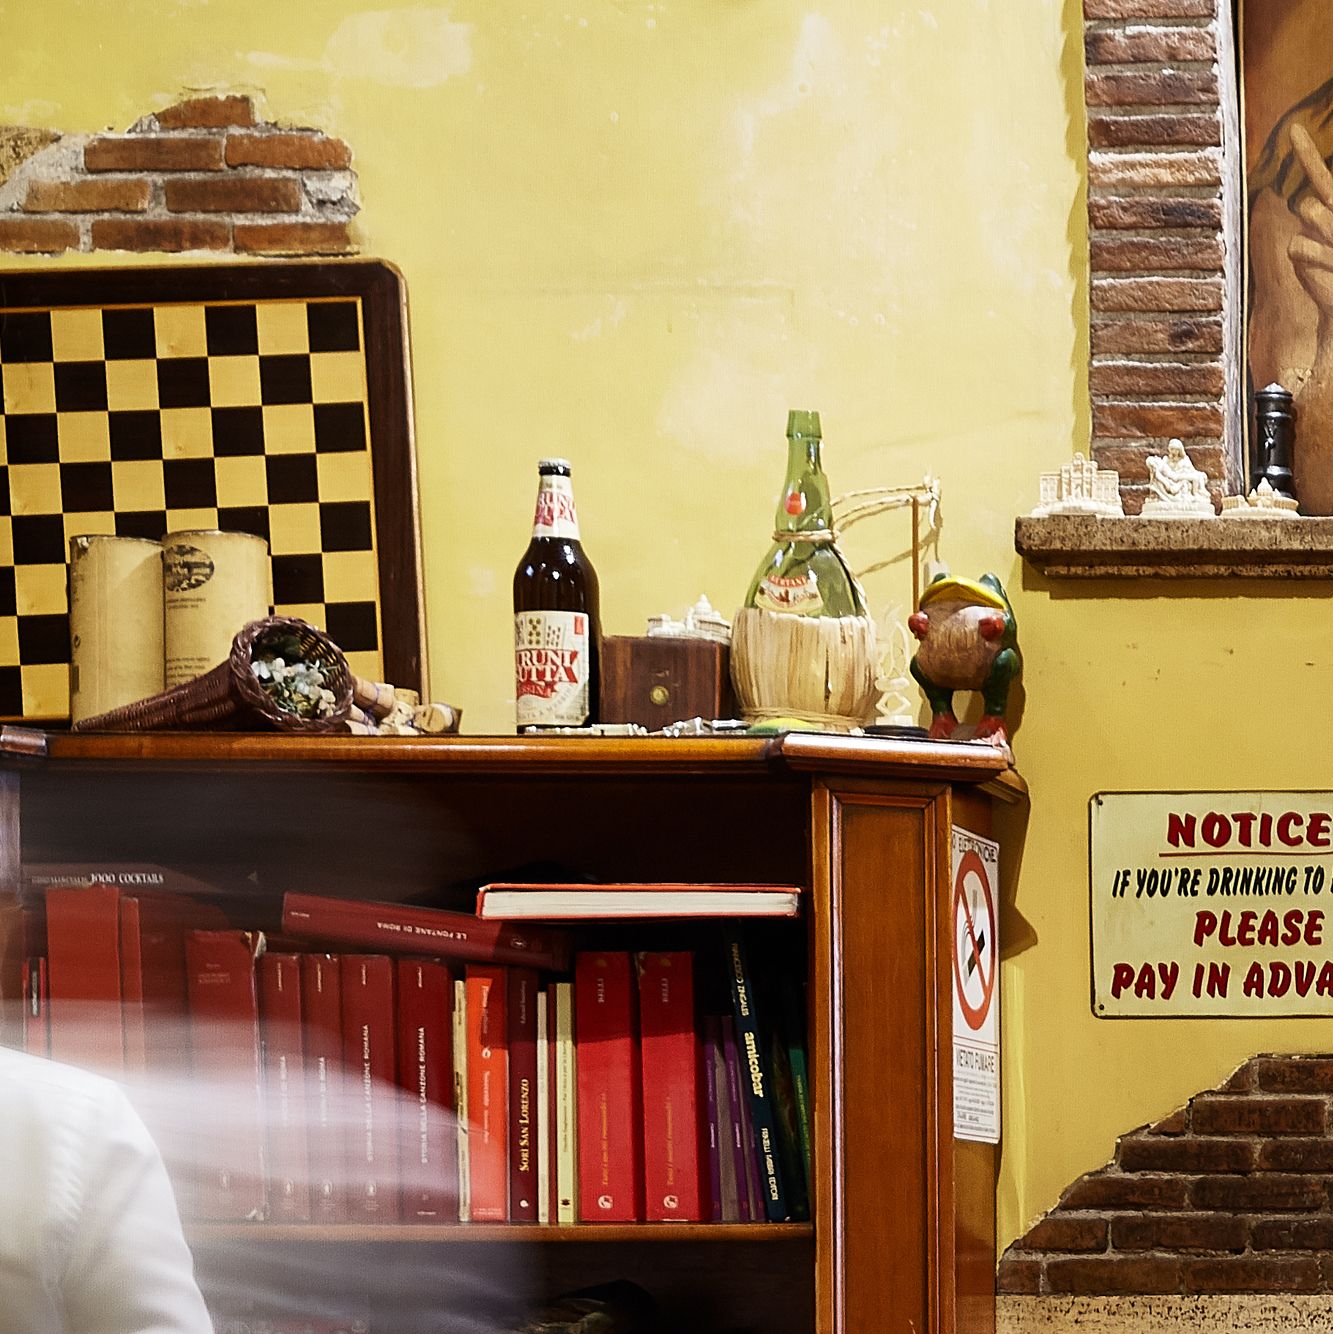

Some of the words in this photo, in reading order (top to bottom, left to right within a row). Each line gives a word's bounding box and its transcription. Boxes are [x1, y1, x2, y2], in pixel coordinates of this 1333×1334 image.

[1112, 869, 1130, 898] IF
[1136, 868, 1202, 899] YOU'RE
[1206, 866, 1297, 897] DRINKING
[1303, 865, 1325, 895] TO
[376, 922, 401, 932] ROMA
[415, 926, 454, 938] FONTANE
[1193, 909, 1326, 947] PLEASE
[1111, 960, 1180, 1000] PAY
[1191, 961, 1231, 998] IN
[363, 1025, 371, 1059] ROMANA
[417, 1027, 426, 1062] ROMANA
[744, 1031, 764, 1098] amicobar
[419, 1065, 427, 1103] CANZONE
[518, 1078, 530, 1125] LORENZO
[519, 1126, 530, 1147] SAN
